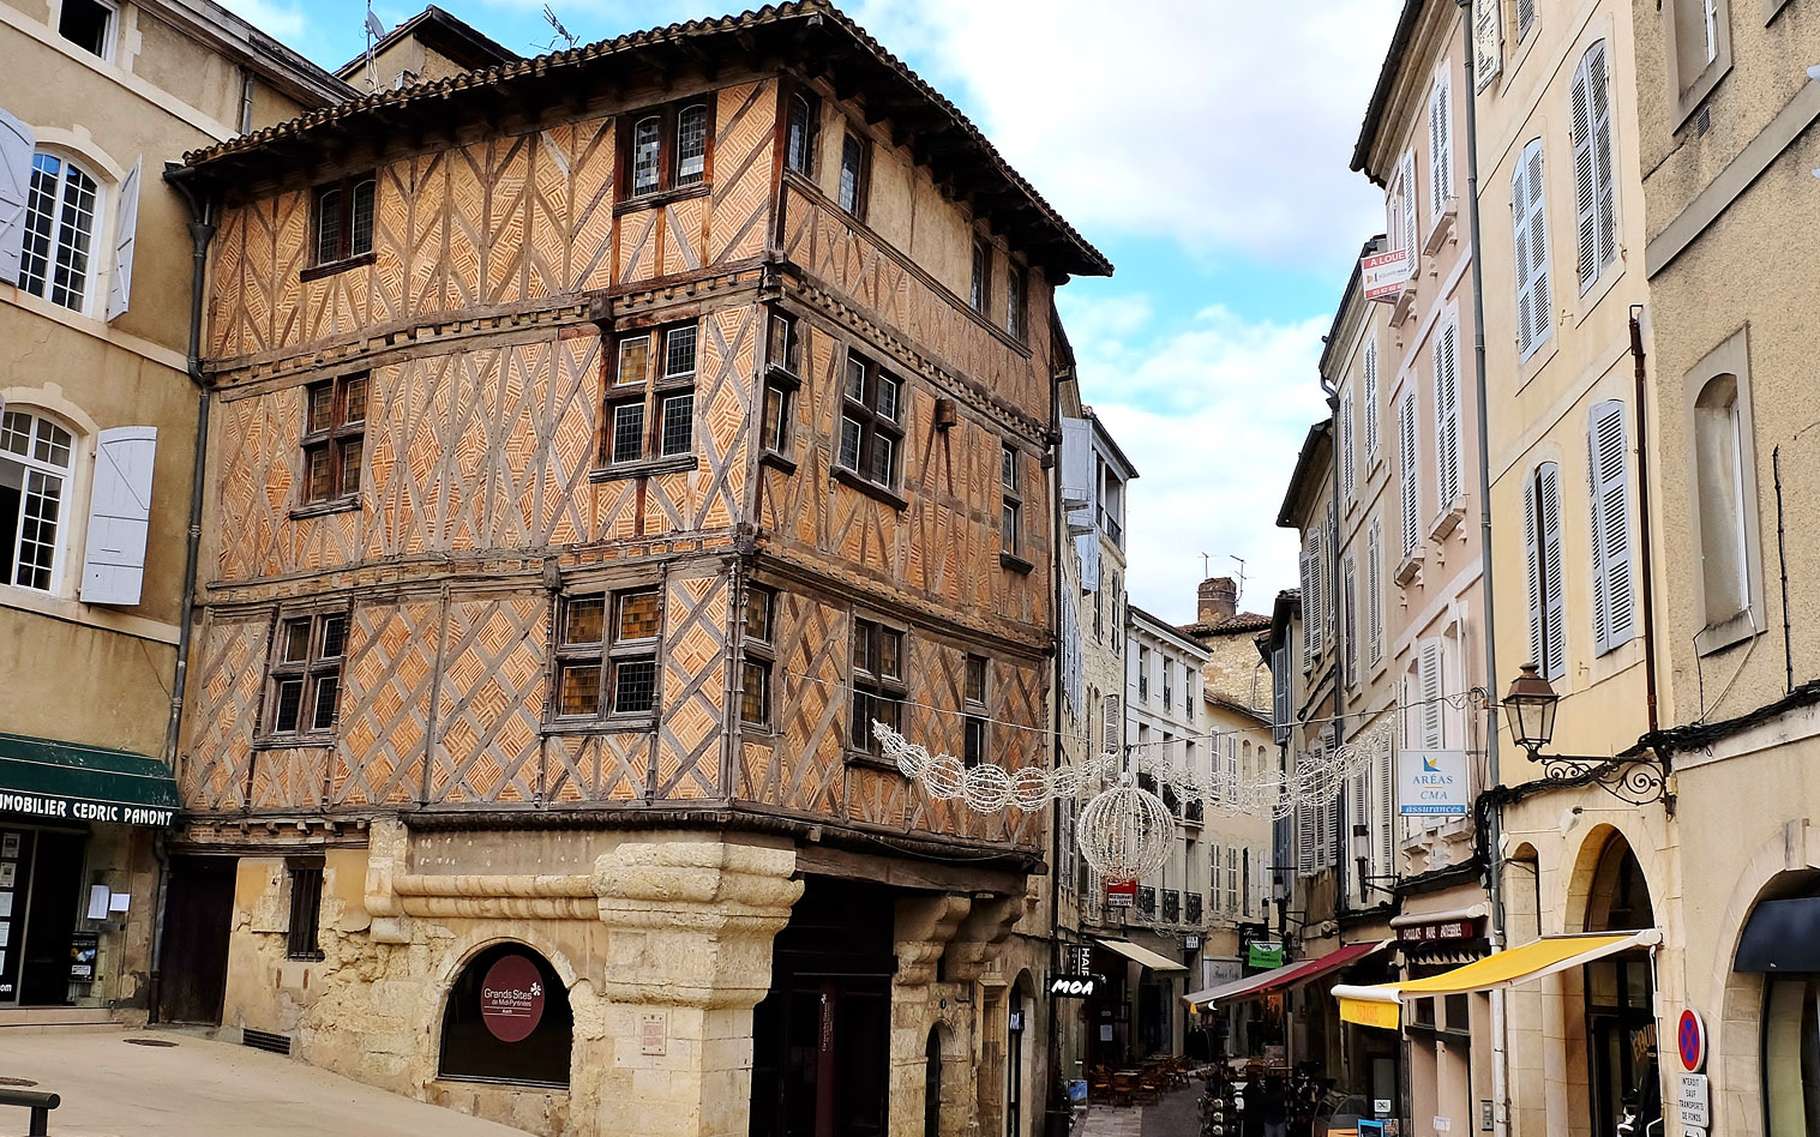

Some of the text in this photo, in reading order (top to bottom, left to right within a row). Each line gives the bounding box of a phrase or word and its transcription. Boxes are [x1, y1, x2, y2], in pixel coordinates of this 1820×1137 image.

[1370, 251, 1406, 267] A LOUE
[1413, 773, 1454, 785] ARÉAS
[1420, 790, 1448, 800] CMA
[0, 793, 67, 818] MOBILIER
[72, 802, 119, 822] CEDRIC
[1405, 804, 1461, 813] assurances
[484, 987, 533, 1000] Grands Sites
[1051, 979, 1094, 995] MOA
